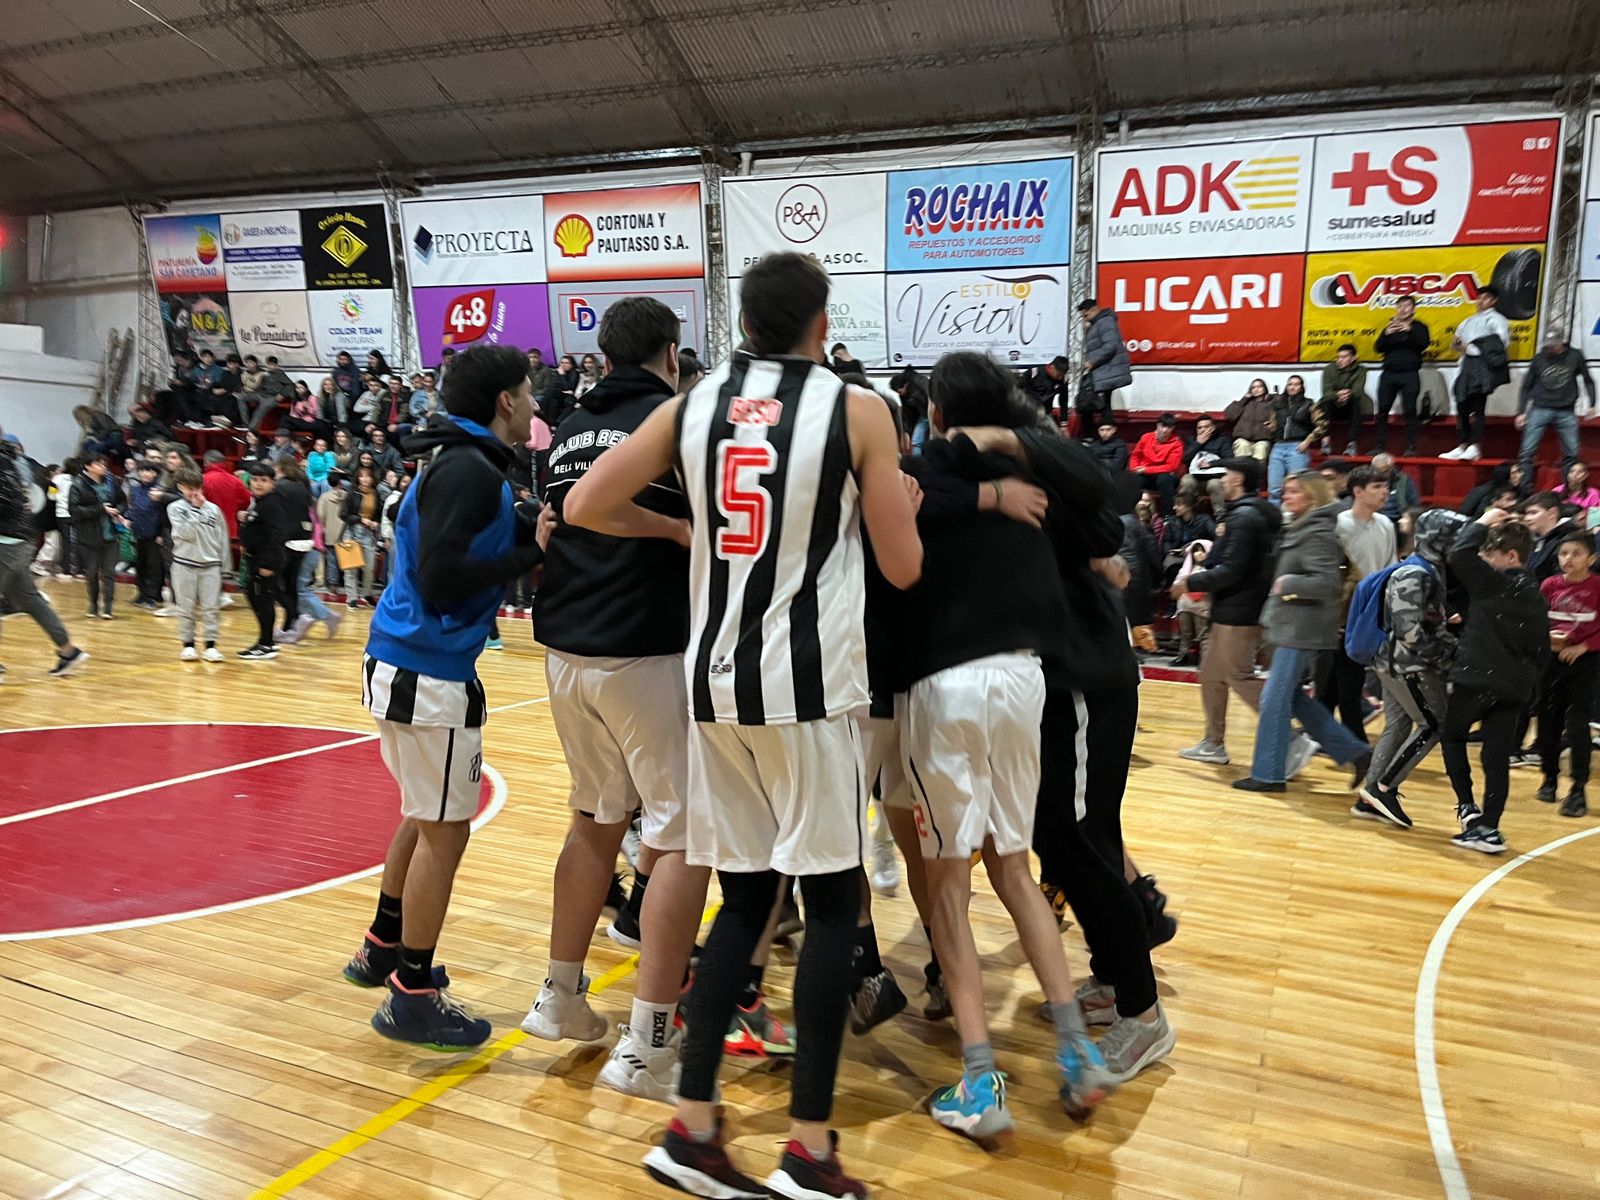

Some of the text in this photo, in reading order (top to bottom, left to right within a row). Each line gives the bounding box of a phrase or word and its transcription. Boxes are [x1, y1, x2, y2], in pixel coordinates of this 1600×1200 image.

[1110, 160, 1243, 218] ADK
[783, 202, 820, 225] P&A
[904, 179, 1048, 237] ROCHAIX
[1328, 209, 1436, 230] sumesalud
[597, 212, 666, 231] CORTONA Y
[1108, 215, 1296, 238] MAQUINAS ENVASADORAS
[434, 230, 533, 254] PROYECTA
[597, 235, 689, 253] PAUTASSO S.A.
[908, 234, 1041, 249] REPUESTOS Y ACCESORIOS
[823, 252, 868, 265] ASOC.
[922, 247, 1025, 260] PARA AUTOMOTORES
[960, 282, 1032, 300] ESTILO
[1115, 273, 1283, 324] LICARI
[1336, 273, 1481, 305] VISCA
[329, 327, 382, 335] COLOR TEAM
[548, 431, 595, 468] CLUB
[717, 440, 778, 560] 5
